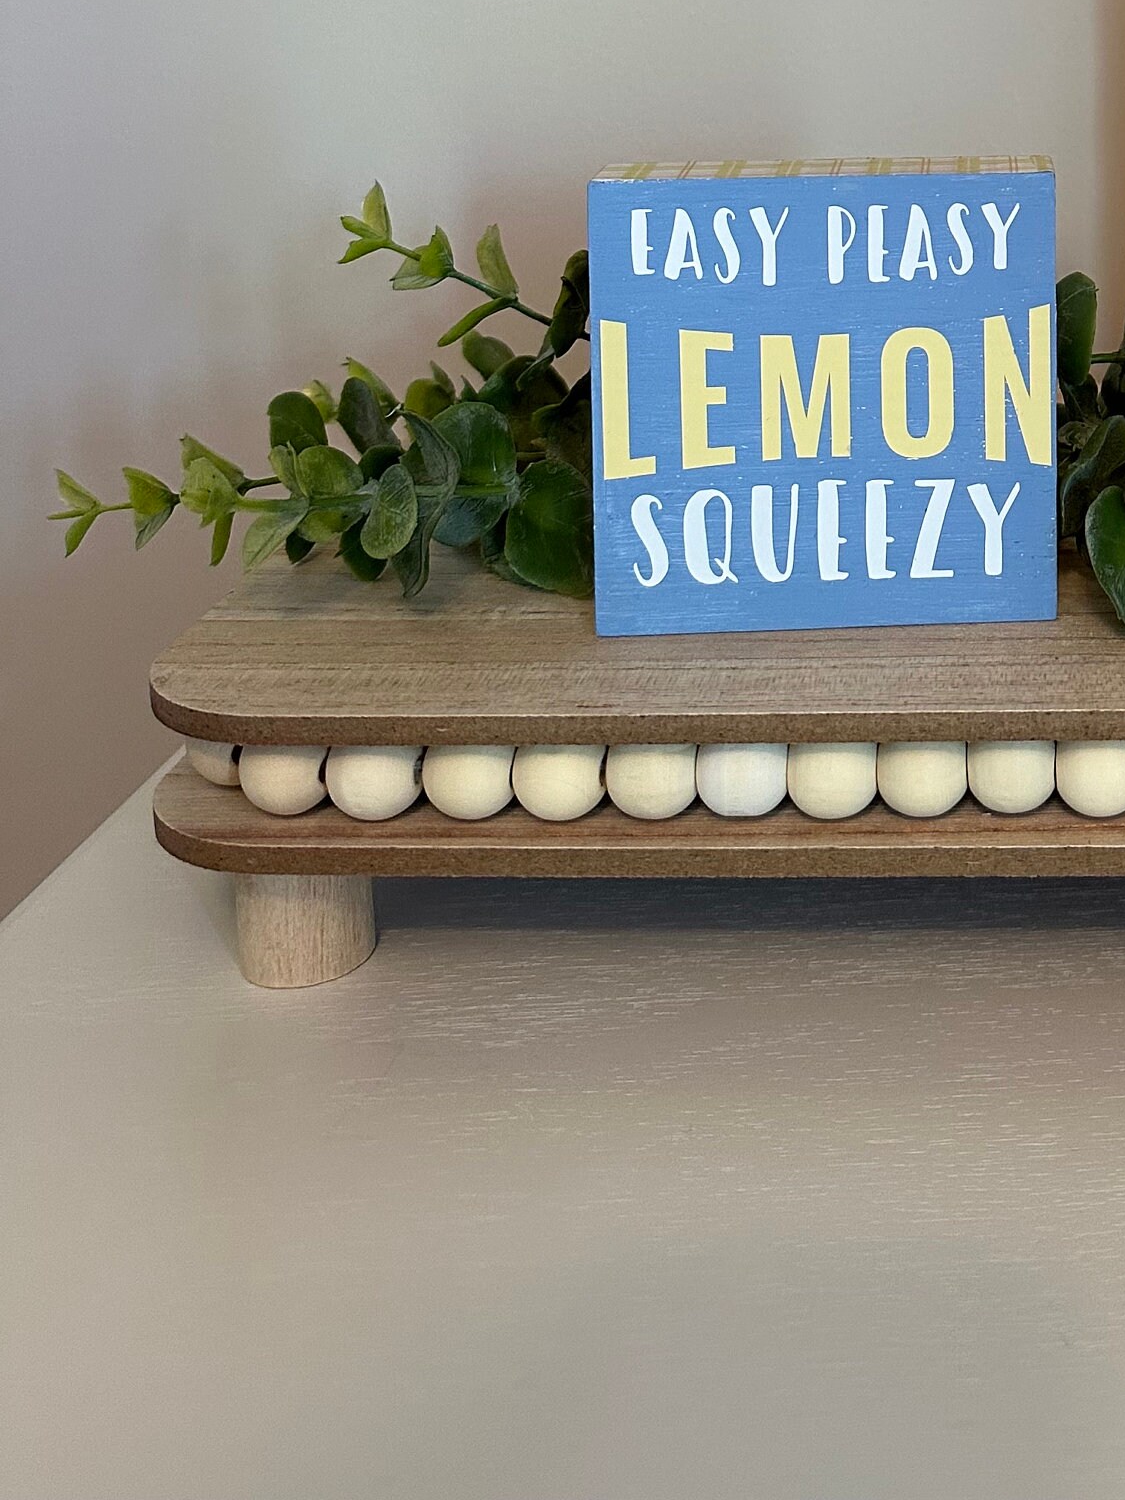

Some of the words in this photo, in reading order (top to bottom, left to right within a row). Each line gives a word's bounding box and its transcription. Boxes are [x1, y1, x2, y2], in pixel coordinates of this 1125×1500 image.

[630, 206, 790, 287] EASY
[826, 202, 1021, 285] PEASY
[599, 303, 1053, 481] LEMON
[630, 478, 1021, 588] SQUEEZY
